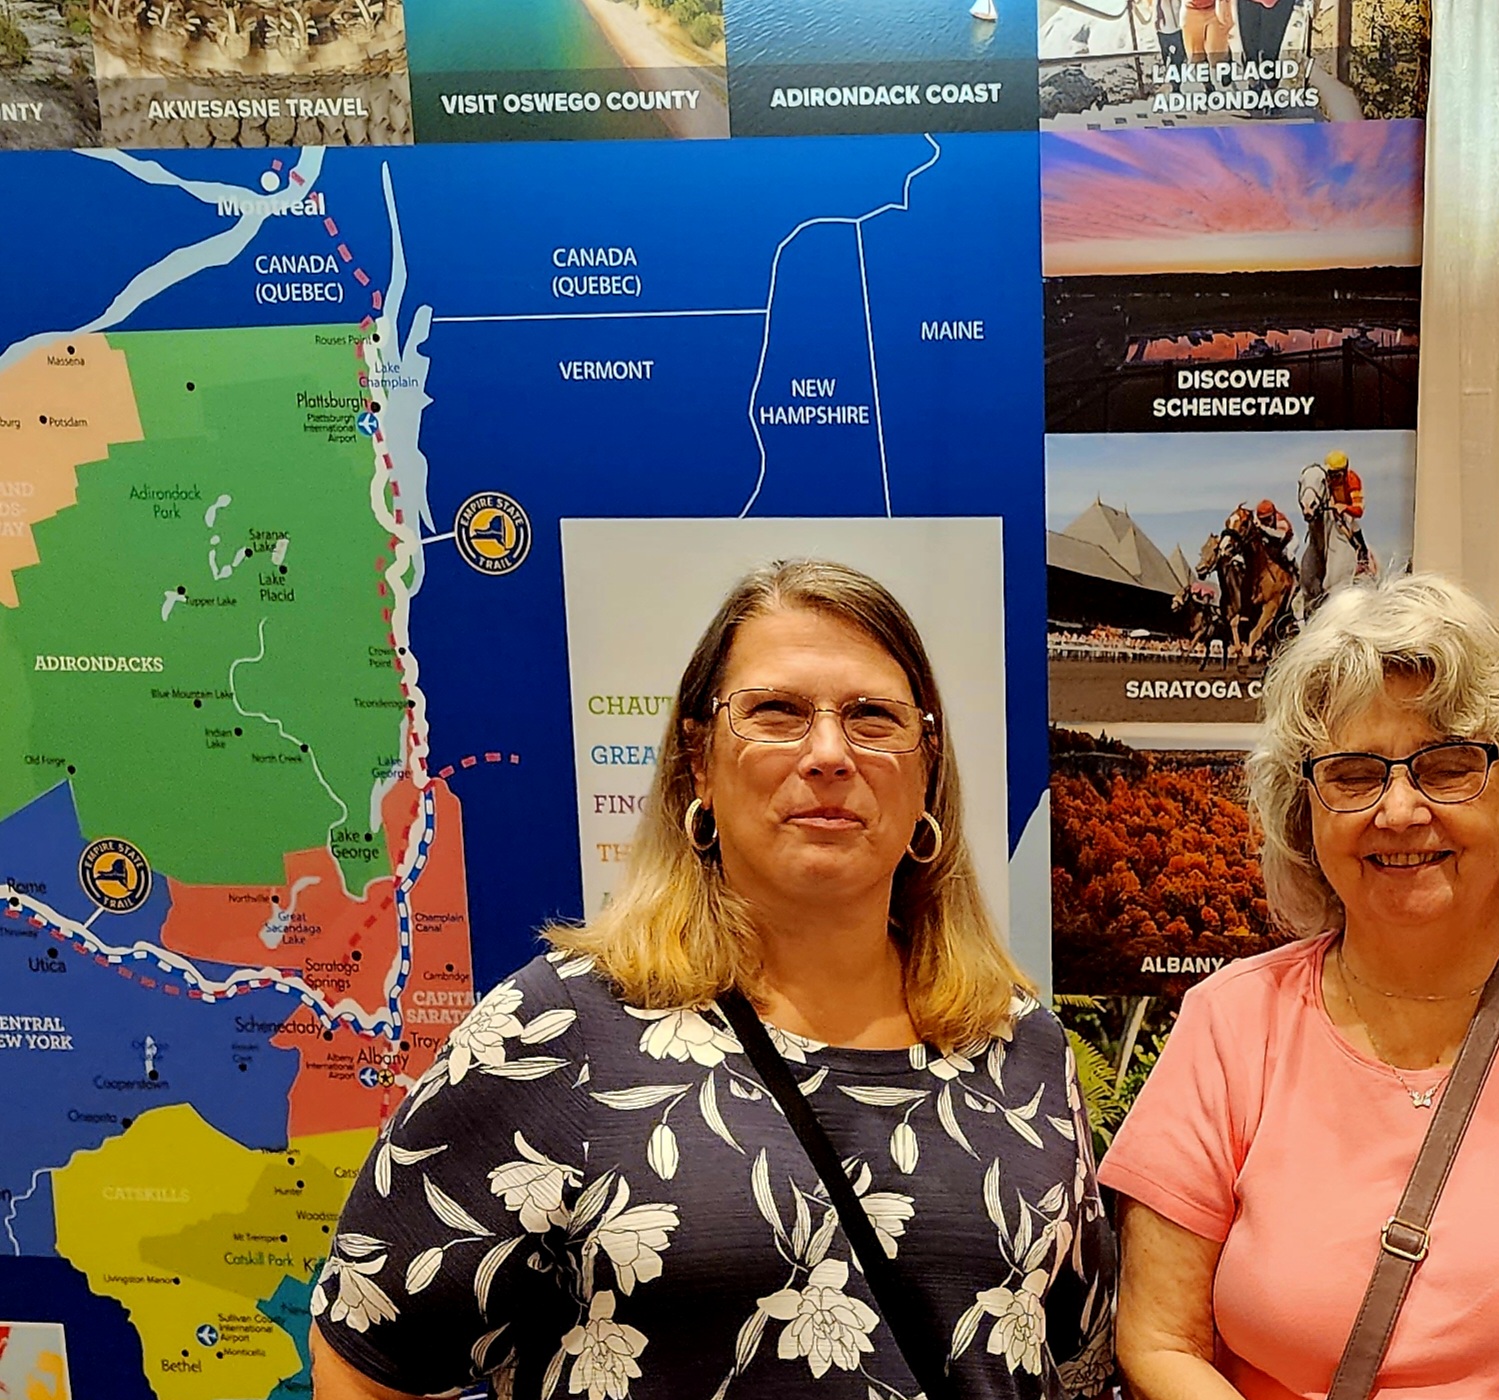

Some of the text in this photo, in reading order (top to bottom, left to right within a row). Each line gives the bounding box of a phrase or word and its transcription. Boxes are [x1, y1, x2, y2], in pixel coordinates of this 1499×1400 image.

[1152, 62, 1213, 85] LAKE
[1217, 59, 1299, 82] PLACID
[442, 90, 700, 115] VISIT OSWEGO COUNTY
[771, 82, 1002, 109] ADIRONDACK COAST
[1152, 88, 1319, 113] ADIRONDACKS
[1, 102, 43, 121] NTY
[149, 97, 368, 119] AKWESASNE TRAVEL
[255, 255, 339, 275] CANADA
[553, 248, 637, 268] CANADA
[255, 281, 344, 303] (QUEBEC)
[552, 275, 641, 298] (QUEBEC)
[921, 321, 984, 340] MAINE
[315, 335, 351, 345] Rouses
[47, 356, 85, 367] Massena
[375, 362, 400, 374] Lake
[559, 361, 654, 380] VERMONT
[1178, 369, 1290, 389] DISCOVER
[359, 375, 419, 390] Champlain
[792, 379, 836, 398] NEW
[297, 393, 369, 411] Plattsburgh
[1153, 397, 1315, 418] SCHENECTADY
[49, 417, 87, 428] Potsdam
[760, 406, 869, 425] HAMPSHIRE
[328, 434, 357, 444] Airport
[130, 485, 202, 501] Adirondack
[154, 504, 181, 519] Park
[460, 497, 525, 527] EMPIRE STATE
[249, 529, 291, 541] Saranac
[478, 555, 513, 571] TRAIL
[259, 573, 286, 586] Lake
[260, 589, 295, 602] Placid
[35, 656, 163, 673] ADIRONDACKS
[1125, 680, 1242, 699] SARATOGA
[378, 757, 402, 767] Lake
[372, 768, 412, 781] George
[330, 829, 360, 843] Lake
[84, 842, 145, 870] EMPIRE STATE
[331, 845, 379, 863] George
[102, 896, 135, 910] TRAIL
[278, 911, 306, 923] Great
[415, 912, 464, 924] Champlain
[265, 923, 322, 935] Sacandaga
[415, 923, 442, 933] Canal
[282, 934, 306, 945] Lake
[28, 957, 66, 974] Utica
[305, 958, 360, 974] Saratoga
[1141, 956, 1224, 974] ALBANY
[306, 974, 351, 991] Springs
[235, 1015, 324, 1036] Schenectady
[26, 1035, 74, 1051] YORK
[410, 1031, 441, 1051] Troy
[357, 1048, 409, 1070] Albany
[102, 1187, 190, 1202] CATSKILLS
[224, 1252, 264, 1266] Catskill
[268, 1253, 294, 1267] Park
[161, 1359, 201, 1373] Bethel
